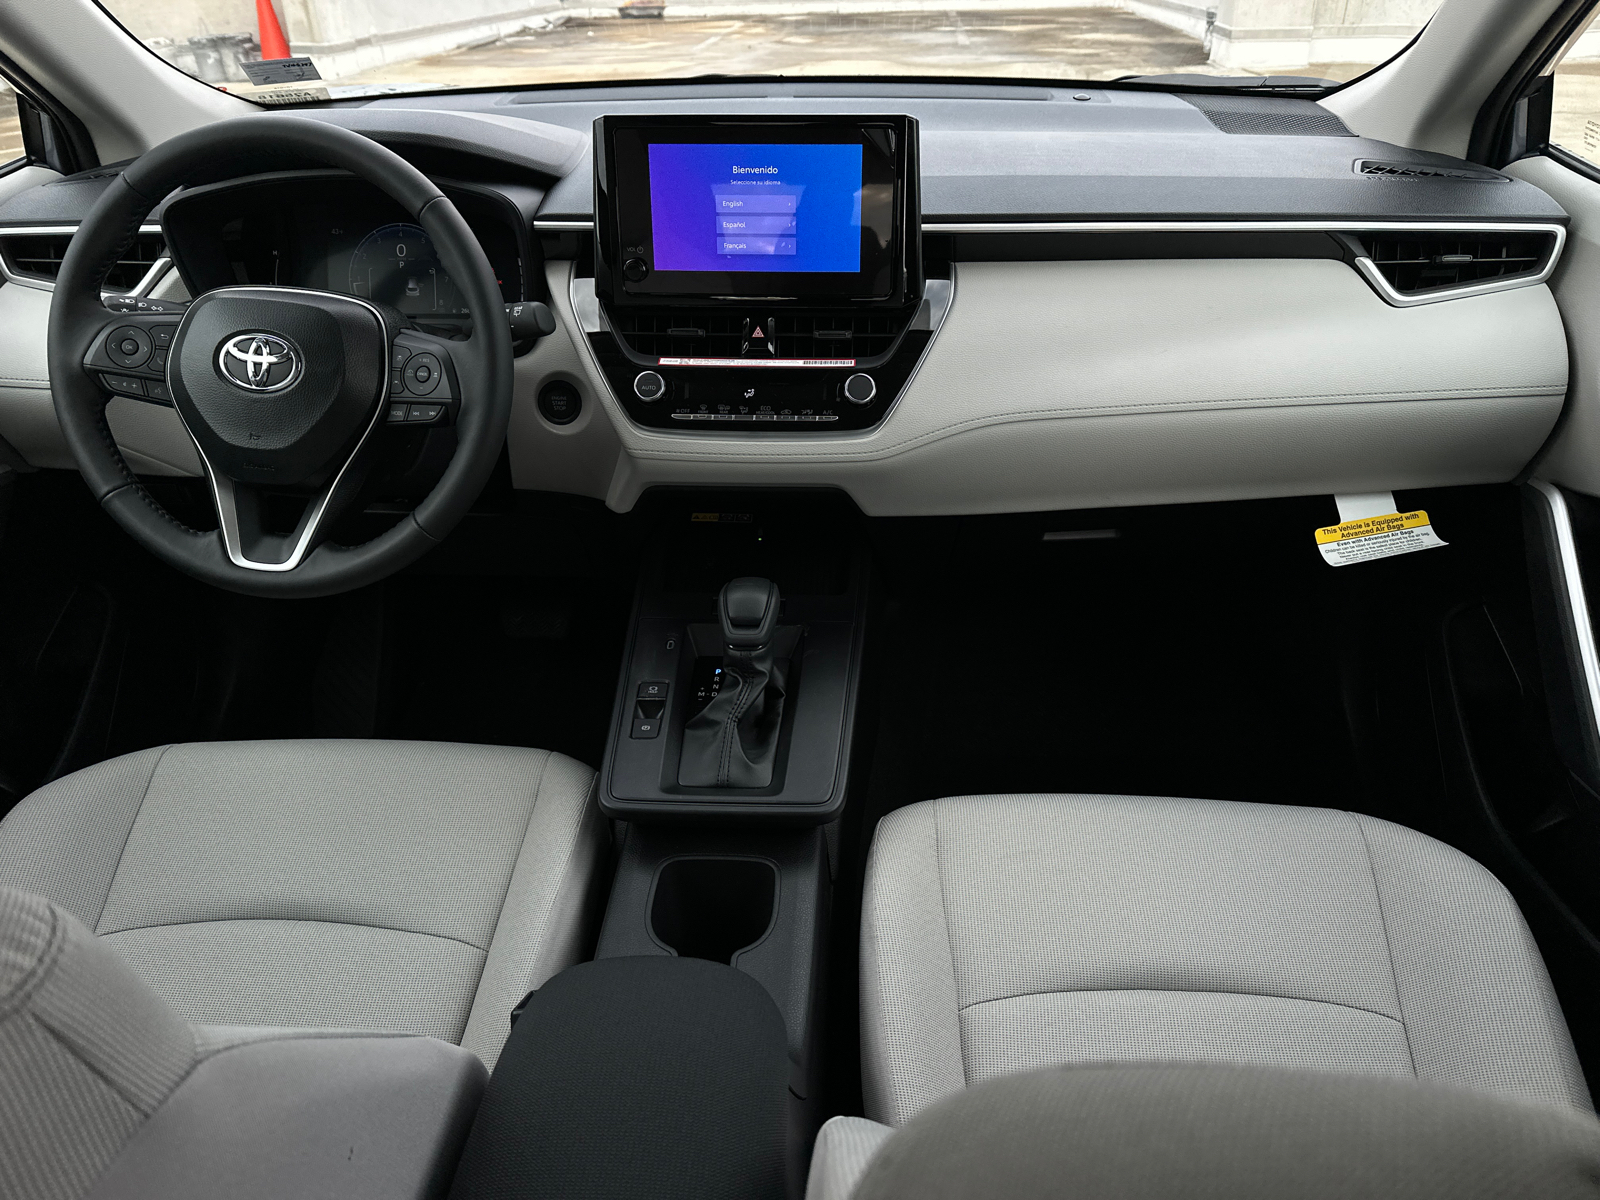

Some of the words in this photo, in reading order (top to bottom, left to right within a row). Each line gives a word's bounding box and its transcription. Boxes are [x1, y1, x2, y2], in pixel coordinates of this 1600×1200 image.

[732, 165, 779, 174] Bienvenido
[396, 244, 406, 257] 0
[1338, 524, 1362, 532] Vehicle
[1372, 516, 1404, 526] Equipped
[1341, 529, 1374, 538] Advanced
[1364, 534, 1390, 542] Advanced
